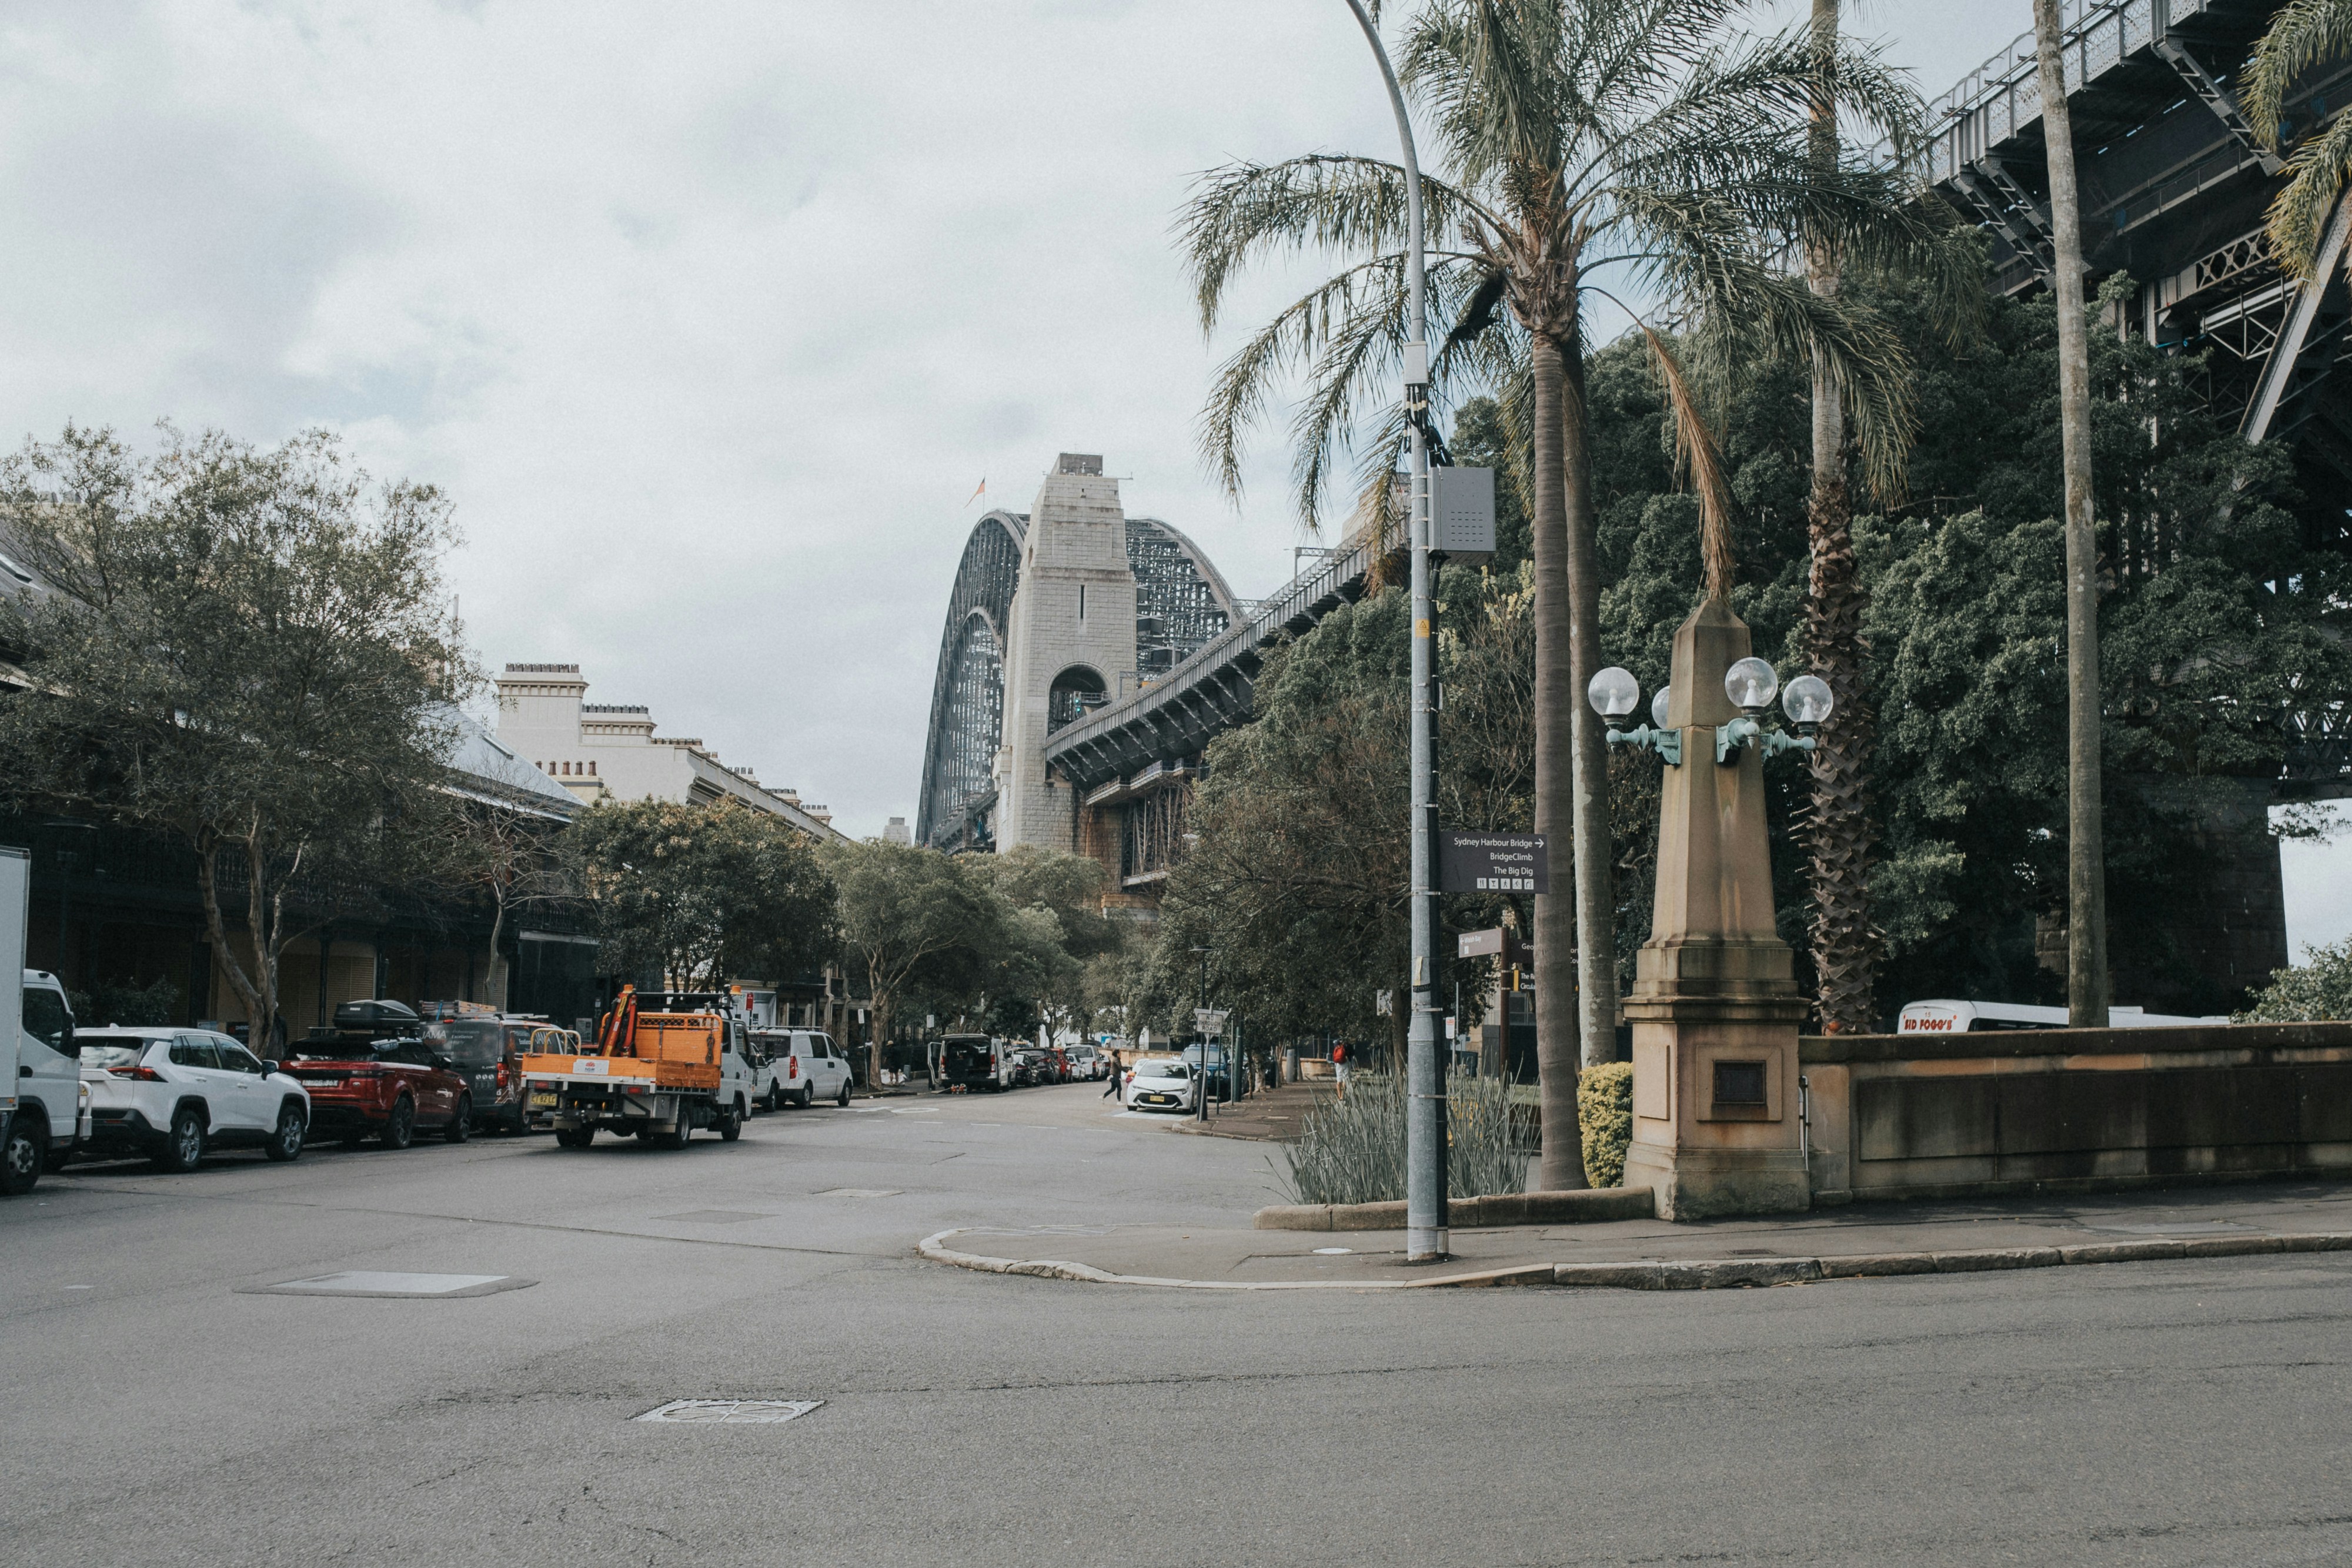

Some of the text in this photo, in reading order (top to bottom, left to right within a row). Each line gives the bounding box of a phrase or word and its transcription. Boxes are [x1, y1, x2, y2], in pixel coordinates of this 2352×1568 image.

[1454, 837, 1533, 848] Sydney Harbour Bridge
[1490, 852, 1533, 862] BridgeClimb
[1508, 867, 1519, 876] Big
[1521, 867, 1534, 877] Dig
[419, 1030, 447, 1039] JAMA
